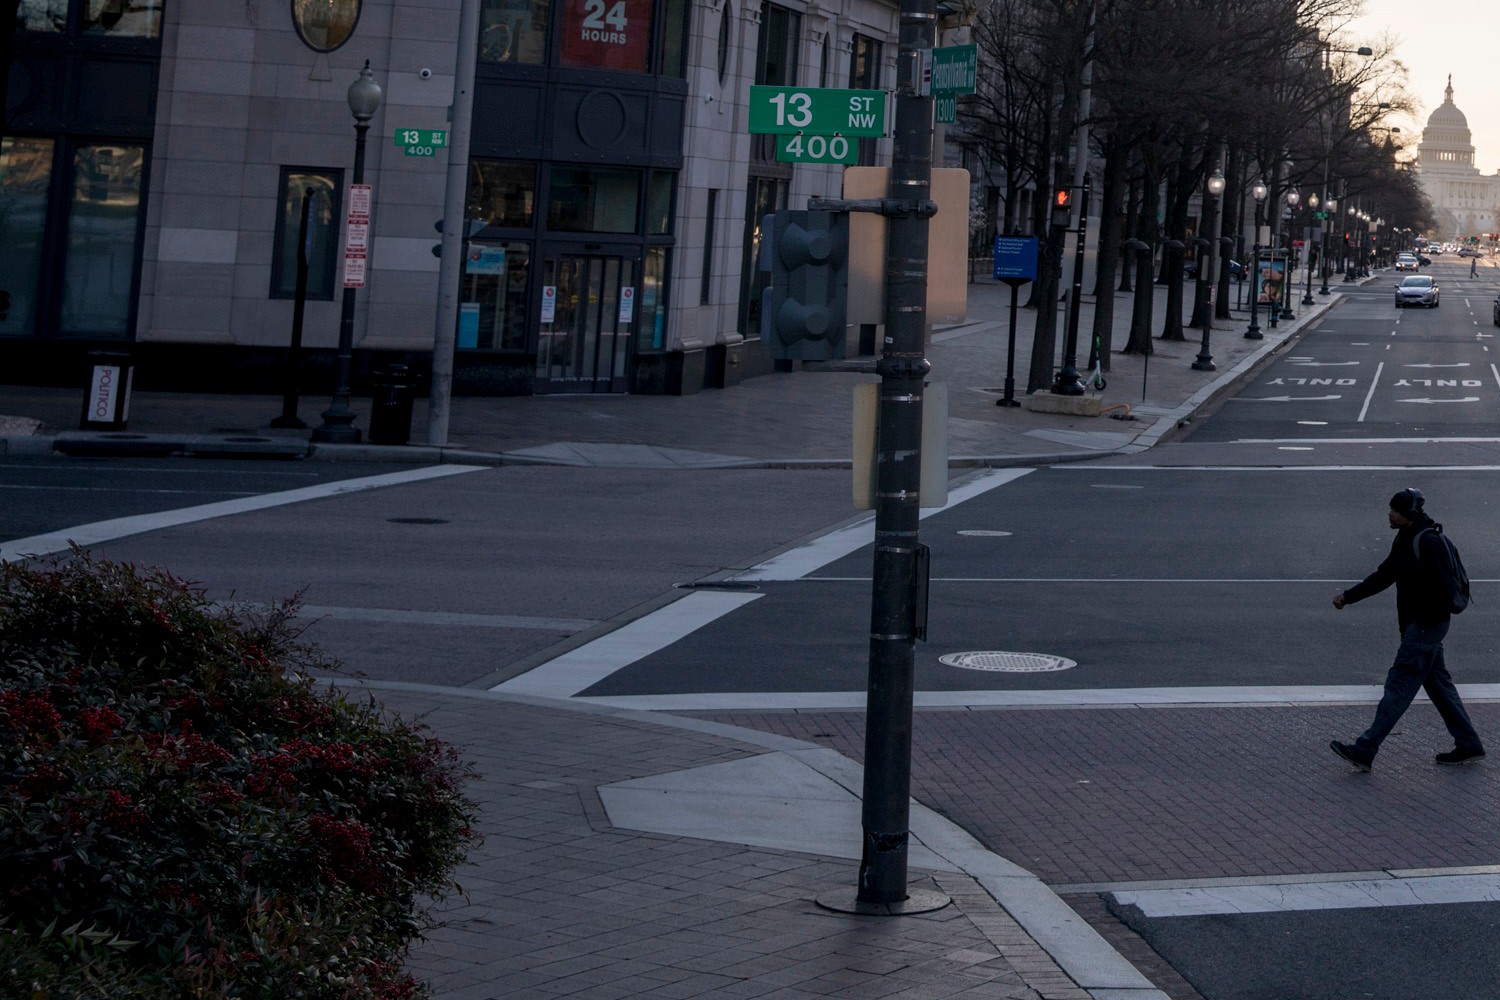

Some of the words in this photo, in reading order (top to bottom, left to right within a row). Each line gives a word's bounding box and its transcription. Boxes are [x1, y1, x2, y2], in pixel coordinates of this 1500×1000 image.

[581, 29, 626, 44] HOURS
[932, 54, 967, 90] Pennsylvania
[769, 92, 813, 127] 13
[849, 96, 874, 112] ST
[937, 98, 954, 121] 1300
[848, 113, 876, 128] NW
[402, 130, 419, 144] 13
[408, 146, 432, 155] 400
[785, 136, 849, 159] 400
[1265, 377, 1358, 387] ONLY
[1392, 378, 1483, 388] ONLY
[96, 369, 112, 417] POLITICO
